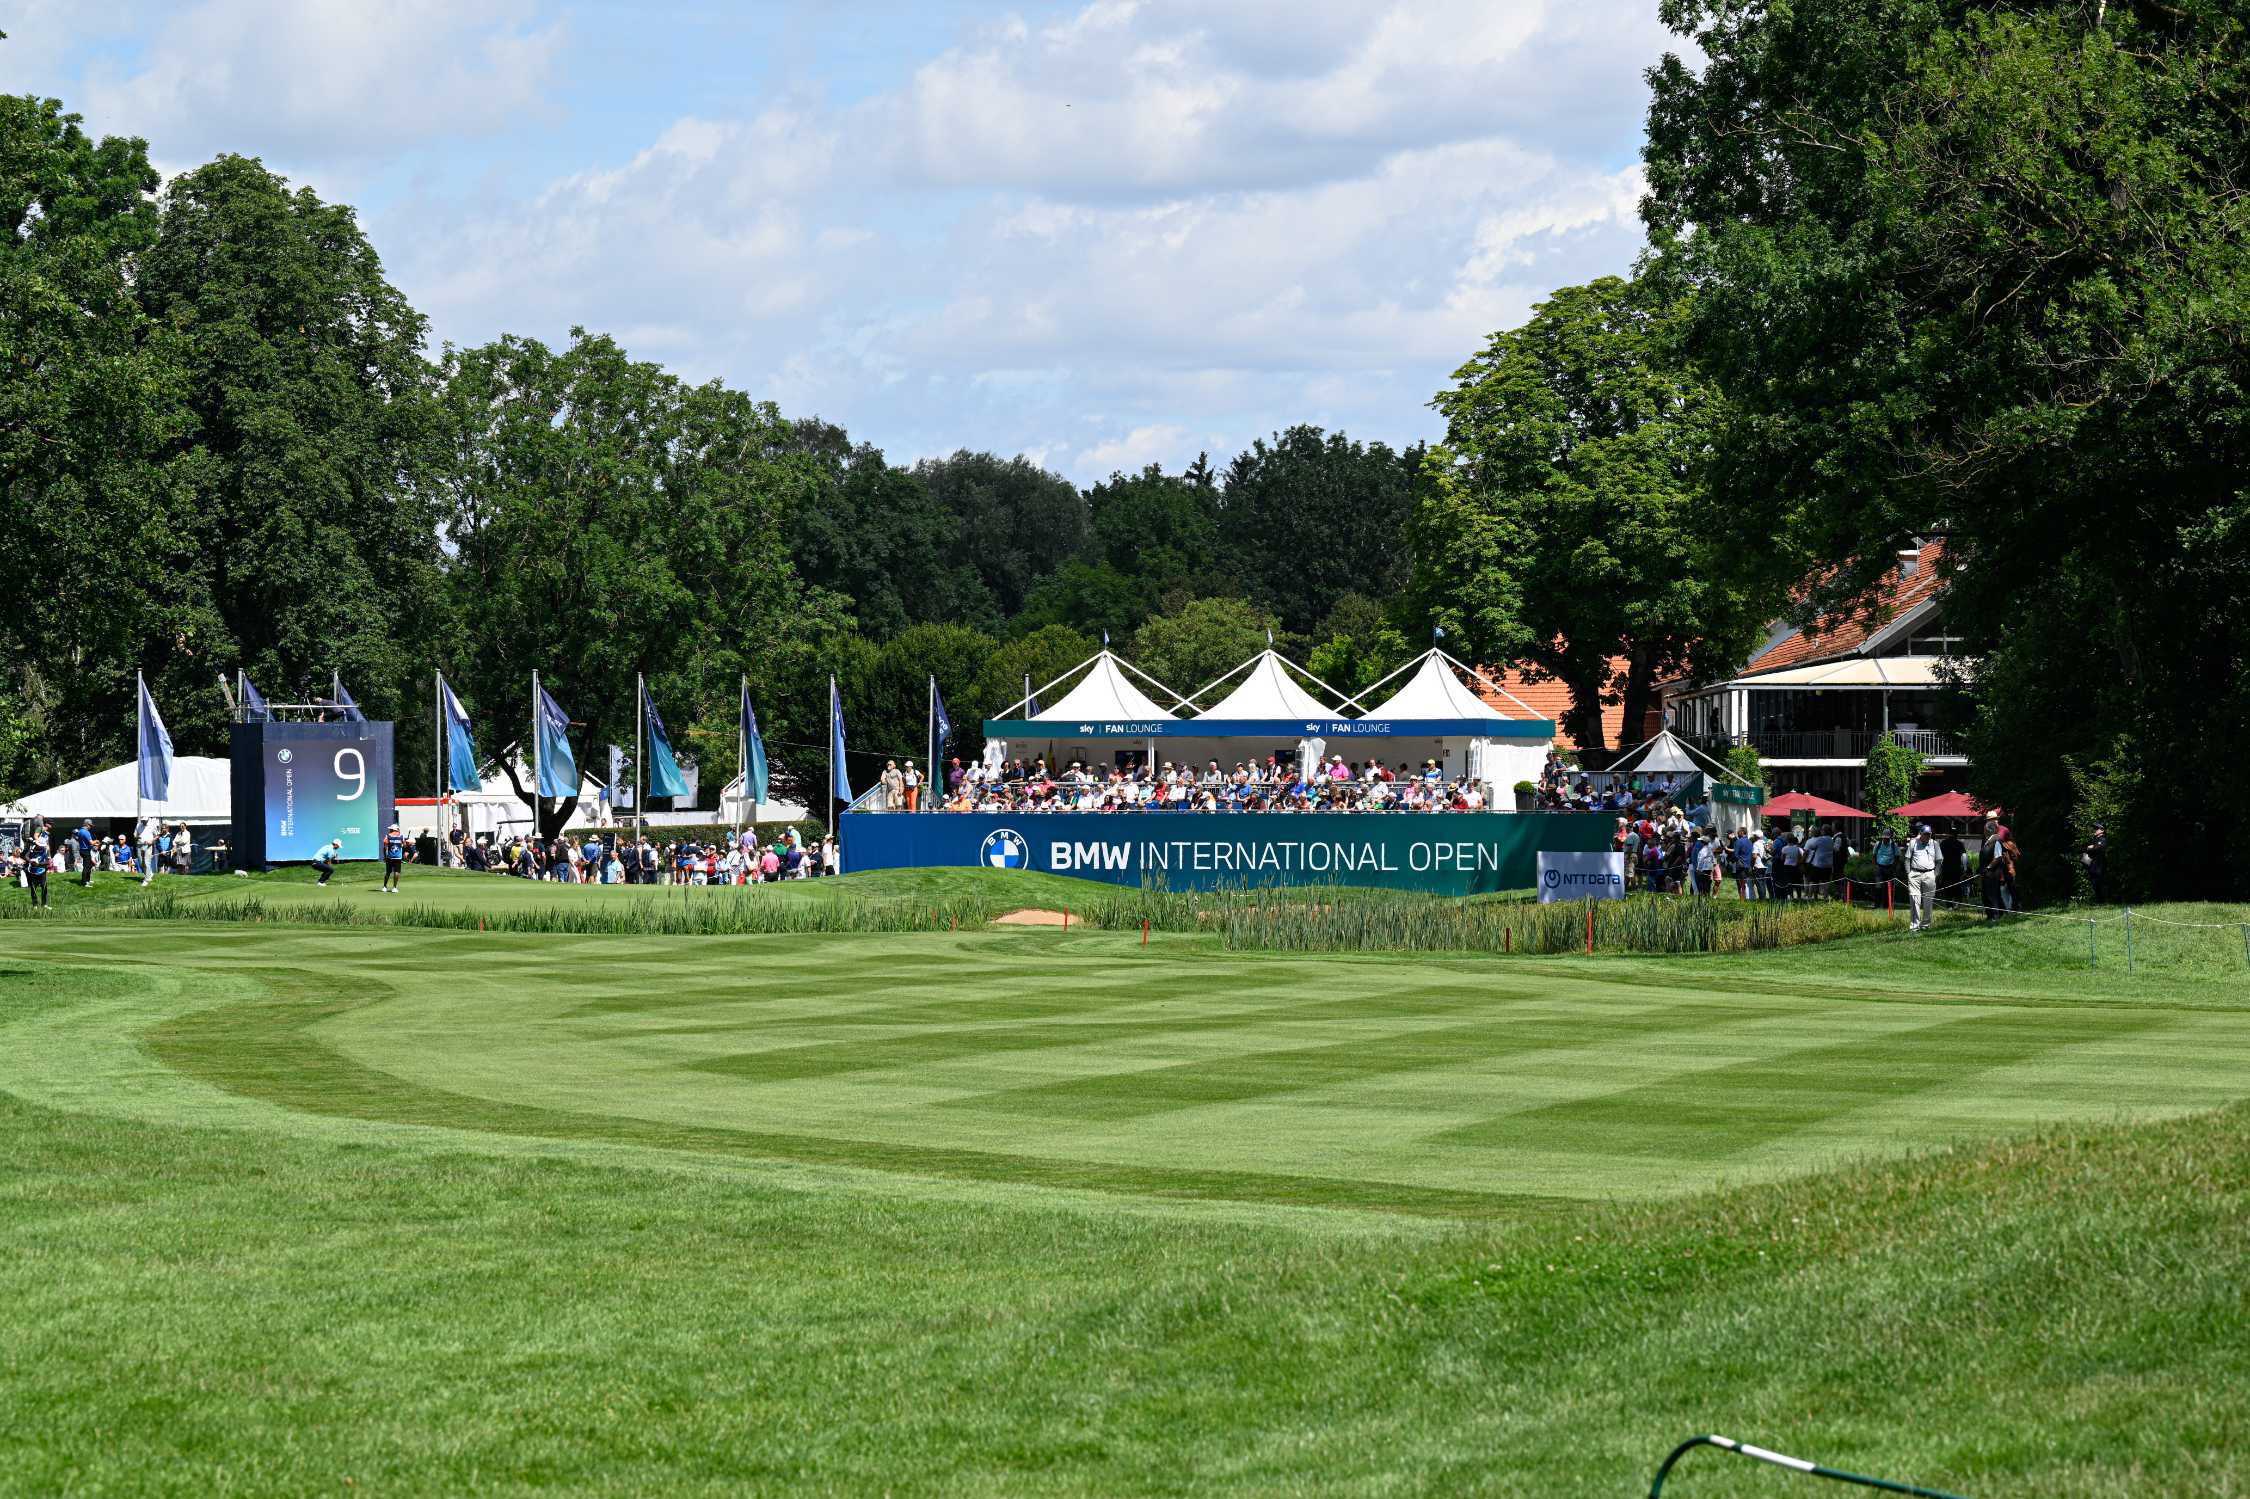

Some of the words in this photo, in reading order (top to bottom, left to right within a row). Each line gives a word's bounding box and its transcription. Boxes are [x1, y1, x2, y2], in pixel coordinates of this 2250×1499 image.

[1079, 723, 1095, 735] sky
[1105, 724, 1124, 734] FAN
[1125, 723, 1164, 734] LOUNGE
[1305, 722, 1321, 734] sky
[1332, 723, 1351, 732] FAN
[1352, 723, 1391, 733] LOUNGE
[333, 748, 366, 801] 9
[986, 831, 1022, 847] BMW
[1051, 842, 1131, 870] BMW
[1140, 842, 1399, 870] INTERNATIONAL
[1409, 842, 1499, 871] OPEN
[1563, 873, 1587, 885] NTT
